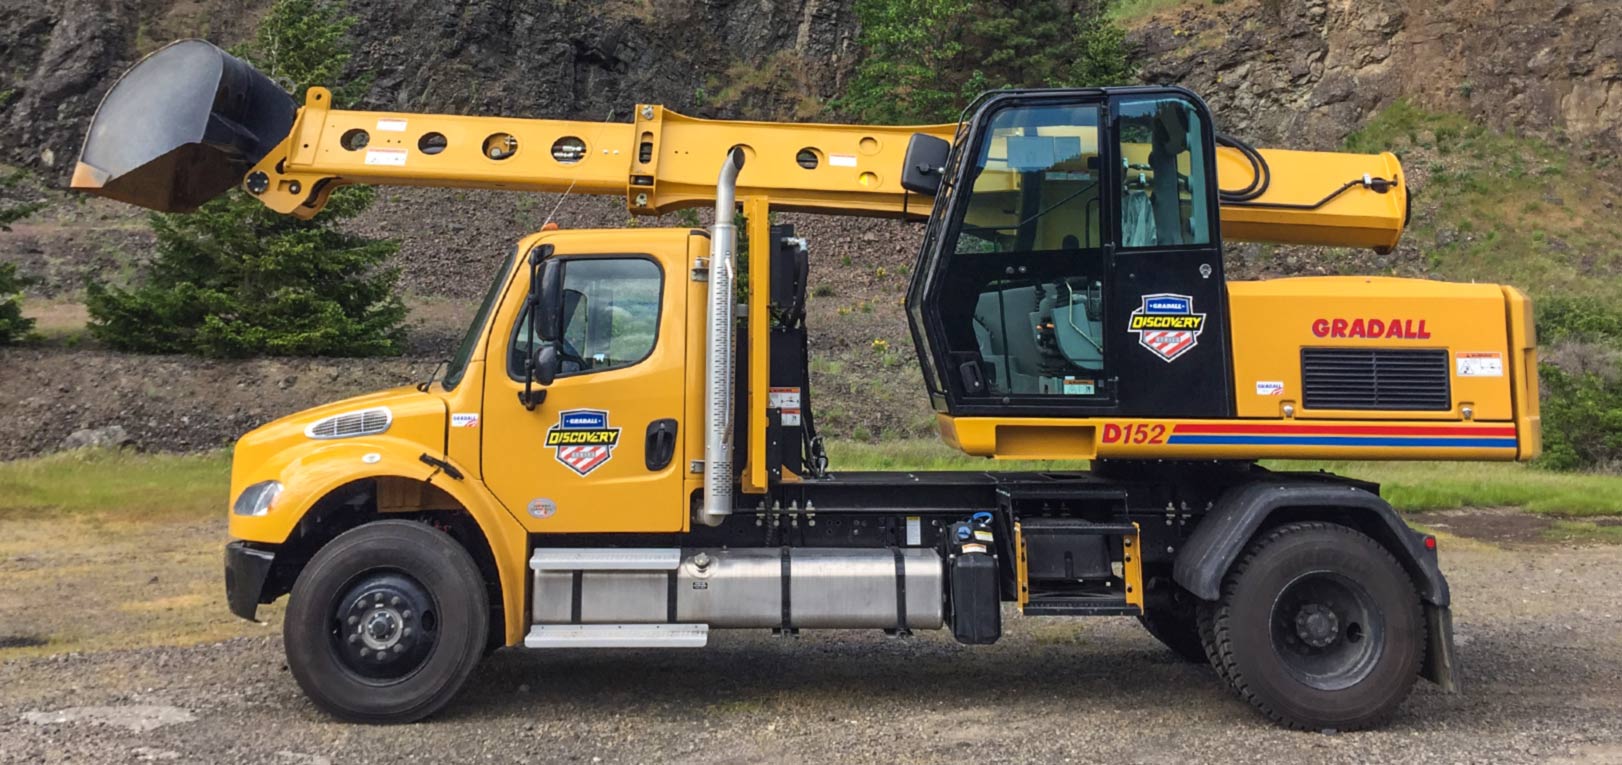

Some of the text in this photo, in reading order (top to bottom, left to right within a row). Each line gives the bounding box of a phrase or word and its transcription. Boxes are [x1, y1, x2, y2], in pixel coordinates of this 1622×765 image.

[1132, 316, 1202, 329] DISCOVERY
[1312, 318, 1431, 339] GRADALL
[548, 432, 618, 445] DISCOVERY
[1102, 423, 1166, 445] D152
